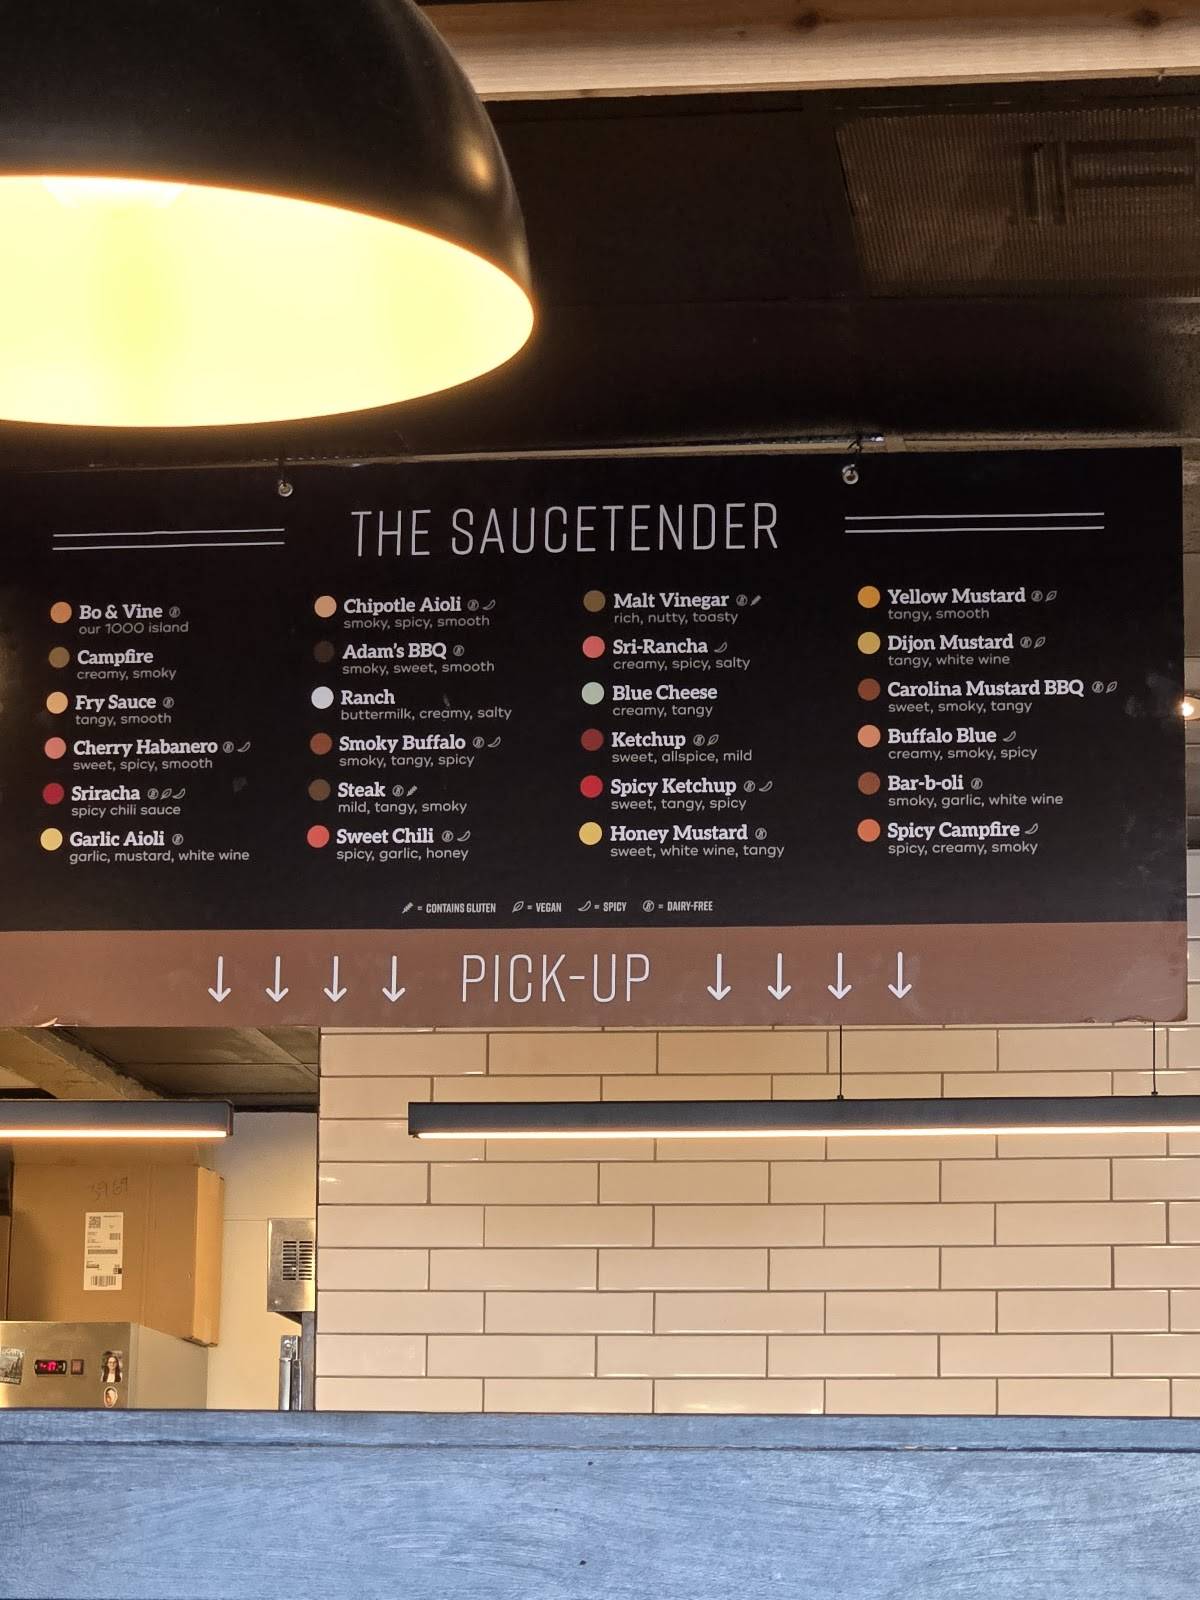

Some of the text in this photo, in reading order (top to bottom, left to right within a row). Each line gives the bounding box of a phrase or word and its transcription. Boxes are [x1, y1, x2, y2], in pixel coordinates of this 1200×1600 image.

[351, 503, 777, 556] THE SAUCETENDER
[614, 592, 729, 610] Malt Vinegar
[888, 587, 1026, 604] Yellow Mustard
[79, 604, 162, 619] Bo & Vine
[344, 596, 461, 616] Chipotle Aioli
[344, 615, 489, 630] smoky, spicy, smooth
[615, 612, 738, 625] rich, nutty, toasty
[888, 608, 989, 622] tangy, smooth
[79, 621, 188, 634] our 1000 island
[613, 638, 708, 654] Sri-Rancha
[888, 633, 1014, 653] Dijon Mustard
[78, 649, 153, 666] Campfire
[342, 642, 446, 660] Adam's BBQ
[343, 661, 494, 676] smoky, sweet, smooth
[613, 657, 750, 671] creamy, spicy, salty
[888, 654, 1010, 668] tangy, white wine
[77, 667, 176, 680] creamy, smoky
[613, 685, 717, 700] Blue Cheese
[888, 679, 1084, 697] Carolina Mustard BBQ
[75, 695, 156, 712] Fry Sauce
[341, 689, 395, 705] Ranch
[341, 706, 512, 720] buttermilk, creamy, salty
[613, 705, 712, 718] creamy, tangy
[889, 700, 1032, 714] sweet, smoky, tangy
[76, 713, 171, 727] tangy, smooth
[612, 731, 686, 749] Ketchup
[888, 727, 996, 743] Buffalo Blue
[74, 739, 218, 757] Cherry Habanero
[339, 734, 466, 753] Smoky Buffalo
[339, 754, 474, 768] smoky, tangy, spicy
[612, 750, 752, 764] sweet, allspice, mild
[889, 746, 1037, 761] creamy, smoky, spicy
[73, 758, 212, 772] sweet, spicy, smooth
[338, 782, 385, 797] Steak
[611, 778, 736, 797] Spicy Ketchup
[888, 775, 964, 790] Bar-b-oli
[72, 785, 140, 801] Sriracha
[889, 793, 1063, 808] smoky, garlic, white wine
[72, 804, 180, 818] spicy chili sauce
[339, 800, 467, 814] mild, tangy, smoky
[611, 797, 746, 811] sweet, tangy, spicy
[70, 831, 164, 846] Garlic Aioli
[337, 828, 434, 844] Sweet Chili
[610, 824, 748, 844] Honey Mustard
[888, 821, 1020, 841] Spicy Campfire
[337, 847, 468, 862] spicy, garlic, honey
[611, 845, 784, 858] sweet, white wine tangy
[888, 841, 1038, 856] spicy, creamy, smoky
[70, 849, 249, 864] garlic, mustard, white wine
[426, 903, 465, 913] CONTAINS
[466, 903, 496, 913] GLUTEN
[536, 902, 562, 912] VEGAN
[603, 902, 626, 912] SPICY
[667, 901, 713, 912] DAIRY-FREE
[463, 953, 650, 1003] PICK-UP
